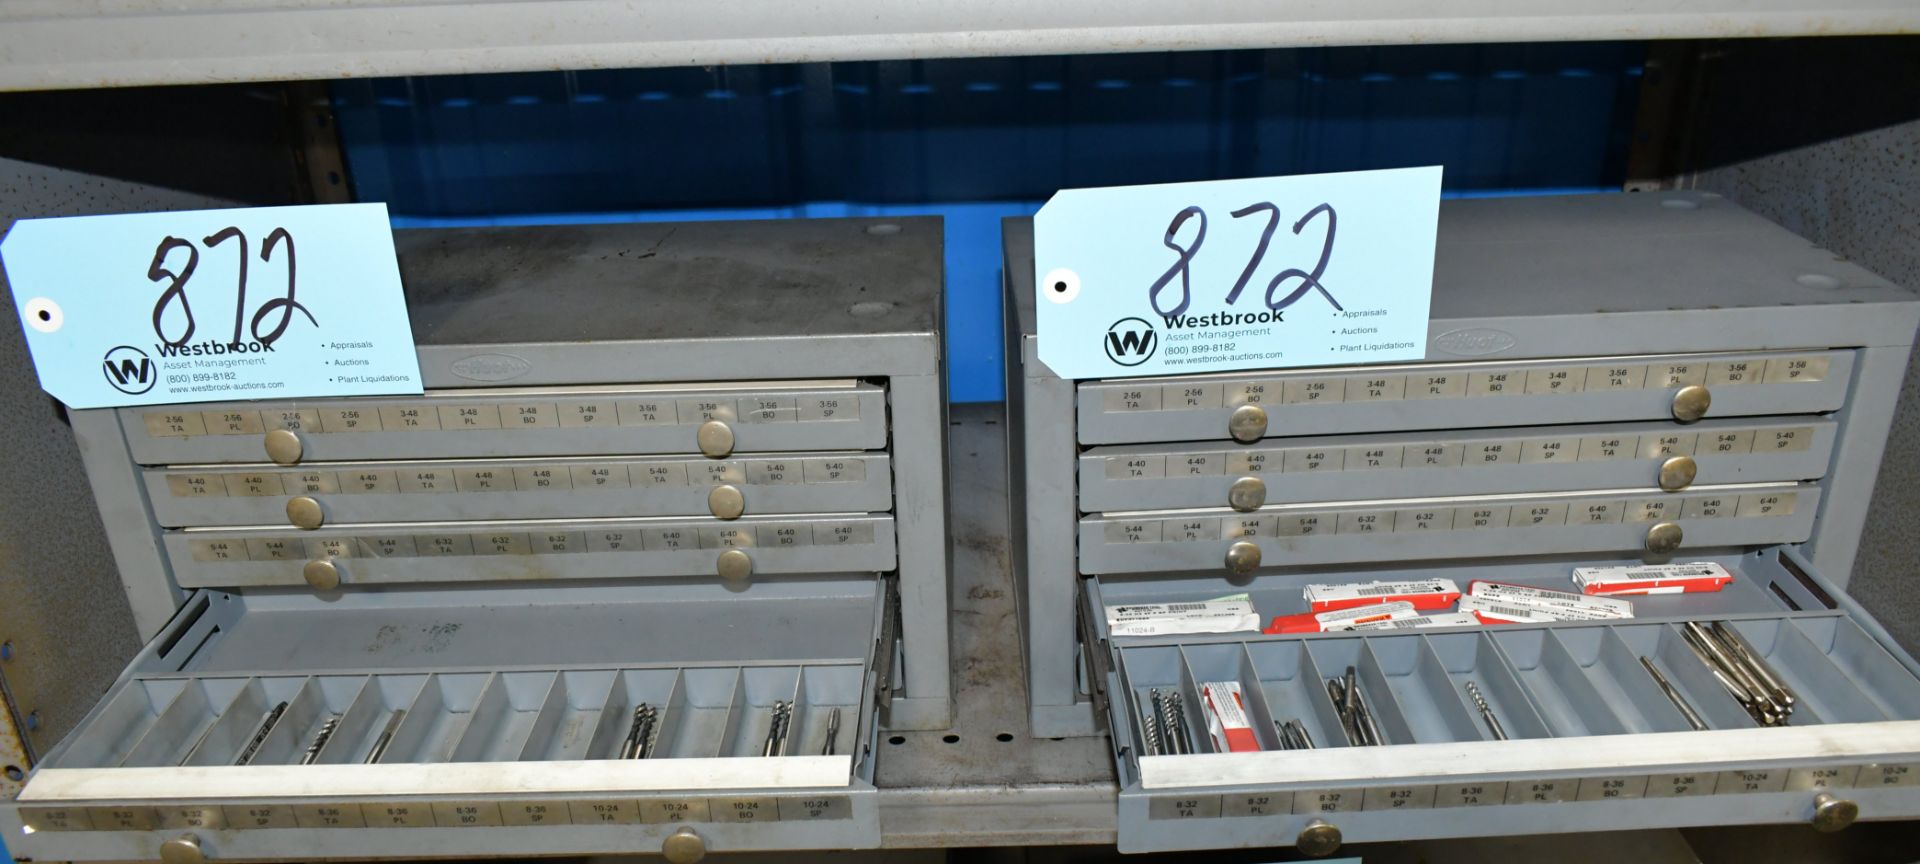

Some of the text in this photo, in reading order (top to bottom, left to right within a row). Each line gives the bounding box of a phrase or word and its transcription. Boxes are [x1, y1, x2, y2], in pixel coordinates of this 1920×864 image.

[1149, 202, 1343, 318] 872
[147, 226, 319, 348] 872
[1342, 308, 1388, 319] Appraisals
[1164, 308, 1285, 330] Westbrook
[1165, 327, 1271, 342] Asset Management
[1340, 326, 1378, 335] Auctions
[155, 340, 275, 358] Westbrook
[330, 340, 374, 351] Appraisals
[1164, 343, 1236, 356] (800) 899-8182
[1340, 341, 1415, 352] Plant Liquidations
[334, 358, 370, 366] Auctions
[1164, 351, 1283, 366] www.westbrook-auctions.com
[163, 357, 267, 370] Asset Management
[1729, 363, 1747, 372] 3-56
[1789, 361, 1807, 369] 3-56
[1609, 369, 1627, 377] 3-56
[1669, 366, 1687, 374] 3-56
[1790, 369, 1801, 378] SP
[166, 372, 237, 385] (800) 899-8182
[337, 373, 410, 383] Plant Liquidations
[1488, 374, 1506, 383] 3-48
[1549, 372, 1567, 380] 3-48
[1671, 375, 1681, 384] PL
[1729, 373, 1742, 381] BO
[1367, 380, 1385, 388] 3-48
[1428, 377, 1446, 385] 3-48
[1551, 380, 1561, 389] SP
[1611, 378, 1622, 386] TA
[169, 381, 285, 394] www.westbrook-auctions.com
[1246, 386, 1264, 394] 2-56
[1306, 383, 1325, 391] 2-56
[1430, 386, 1441, 394] PL
[1490, 384, 1502, 392] BO
[1123, 392, 1141, 400] 2-56
[1184, 389, 1203, 397] 2-56
[1309, 392, 1320, 400] SP
[1369, 389, 1381, 397] TA
[1187, 398, 1198, 406] PL
[1248, 395, 1260, 403] BO
[639, 404, 657, 412] 3-56
[759, 401, 777, 409] 3-56
[1126, 401, 1139, 409] TA
[400, 409, 418, 418] 3-48
[519, 407, 537, 415] 3-48
[579, 406, 597, 414] 3-48
[823, 409, 834, 417] SP
[223, 414, 242, 422] 2-56
[341, 411, 360, 419] 2-56
[643, 413, 656, 421] TA
[703, 412, 714, 420] PL
[762, 411, 775, 419] BO
[464, 417, 476, 425] PL
[523, 416, 536, 424] BO
[1718, 434, 1736, 443] 5-40
[1776, 431, 1795, 439] 5-40
[1601, 440, 1619, 448] 5-40
[1660, 437, 1678, 445] 5-40
[1778, 440, 1788, 448] SP
[1484, 445, 1502, 453] 4-48
[1661, 445, 1672, 454] PL
[1719, 443, 1732, 451] BO
[1366, 450, 1383, 458] 4-48
[1544, 451, 1555, 459] SP
[1603, 448, 1615, 456] TA
[1247, 455, 1265, 463] 4-40
[1427, 456, 1437, 464] PL
[1485, 454, 1497, 462] BO
[826, 462, 844, 470] 5-40
[1127, 460, 1146, 468] 4-40
[1309, 462, 1319, 470] SP
[1368, 459, 1380, 467] TA
[649, 467, 668, 475] 5-40
[767, 464, 785, 472] 5-40
[1190, 466, 1201, 474] PL
[1249, 464, 1261, 472] BO
[417, 473, 435, 481] 4-48
[830, 471, 840, 479] SP
[1130, 469, 1143, 477] TA
[359, 474, 377, 482] 4-40
[713, 474, 723, 482] PL
[307, 484, 319, 492] BO
[1703, 500, 1721, 508] 6-40
[1760, 497, 1778, 505] 6-40
[1589, 505, 1607, 513] 6-40
[1646, 502, 1664, 510] 6-40
[1761, 505, 1772, 513] SP
[1531, 507, 1549, 516] 6-32
[1647, 511, 1658, 519] PL
[1704, 508, 1716, 516] BO
[1358, 515, 1376, 523] 6-32
[1416, 513, 1434, 521] 6-32
[1533, 516, 1543, 524] SP
[1590, 513, 1602, 521] TA
[1241, 520, 1259, 528] 5-44
[1300, 518, 1318, 526] 5-44
[1418, 521, 1428, 529] PL
[1125, 525, 1142, 533] 5-44
[1184, 523, 1201, 531] 5-44
[1186, 531, 1197, 539] PL
[724, 538, 734, 546] PL
[327, 548, 340, 556] BO
[1812, 769, 1838, 778] 10-24
[1673, 777, 1695, 785] 8-36
[1815, 779, 1827, 787] PL
[1461, 787, 1483, 795] 8-36
[1319, 793, 1340, 802] 8-32
[663, 803, 688, 812] 10-24
[733, 802, 759, 810] 10-24
[1393, 799, 1405, 808] SP
[188, 818, 202, 826] BO
